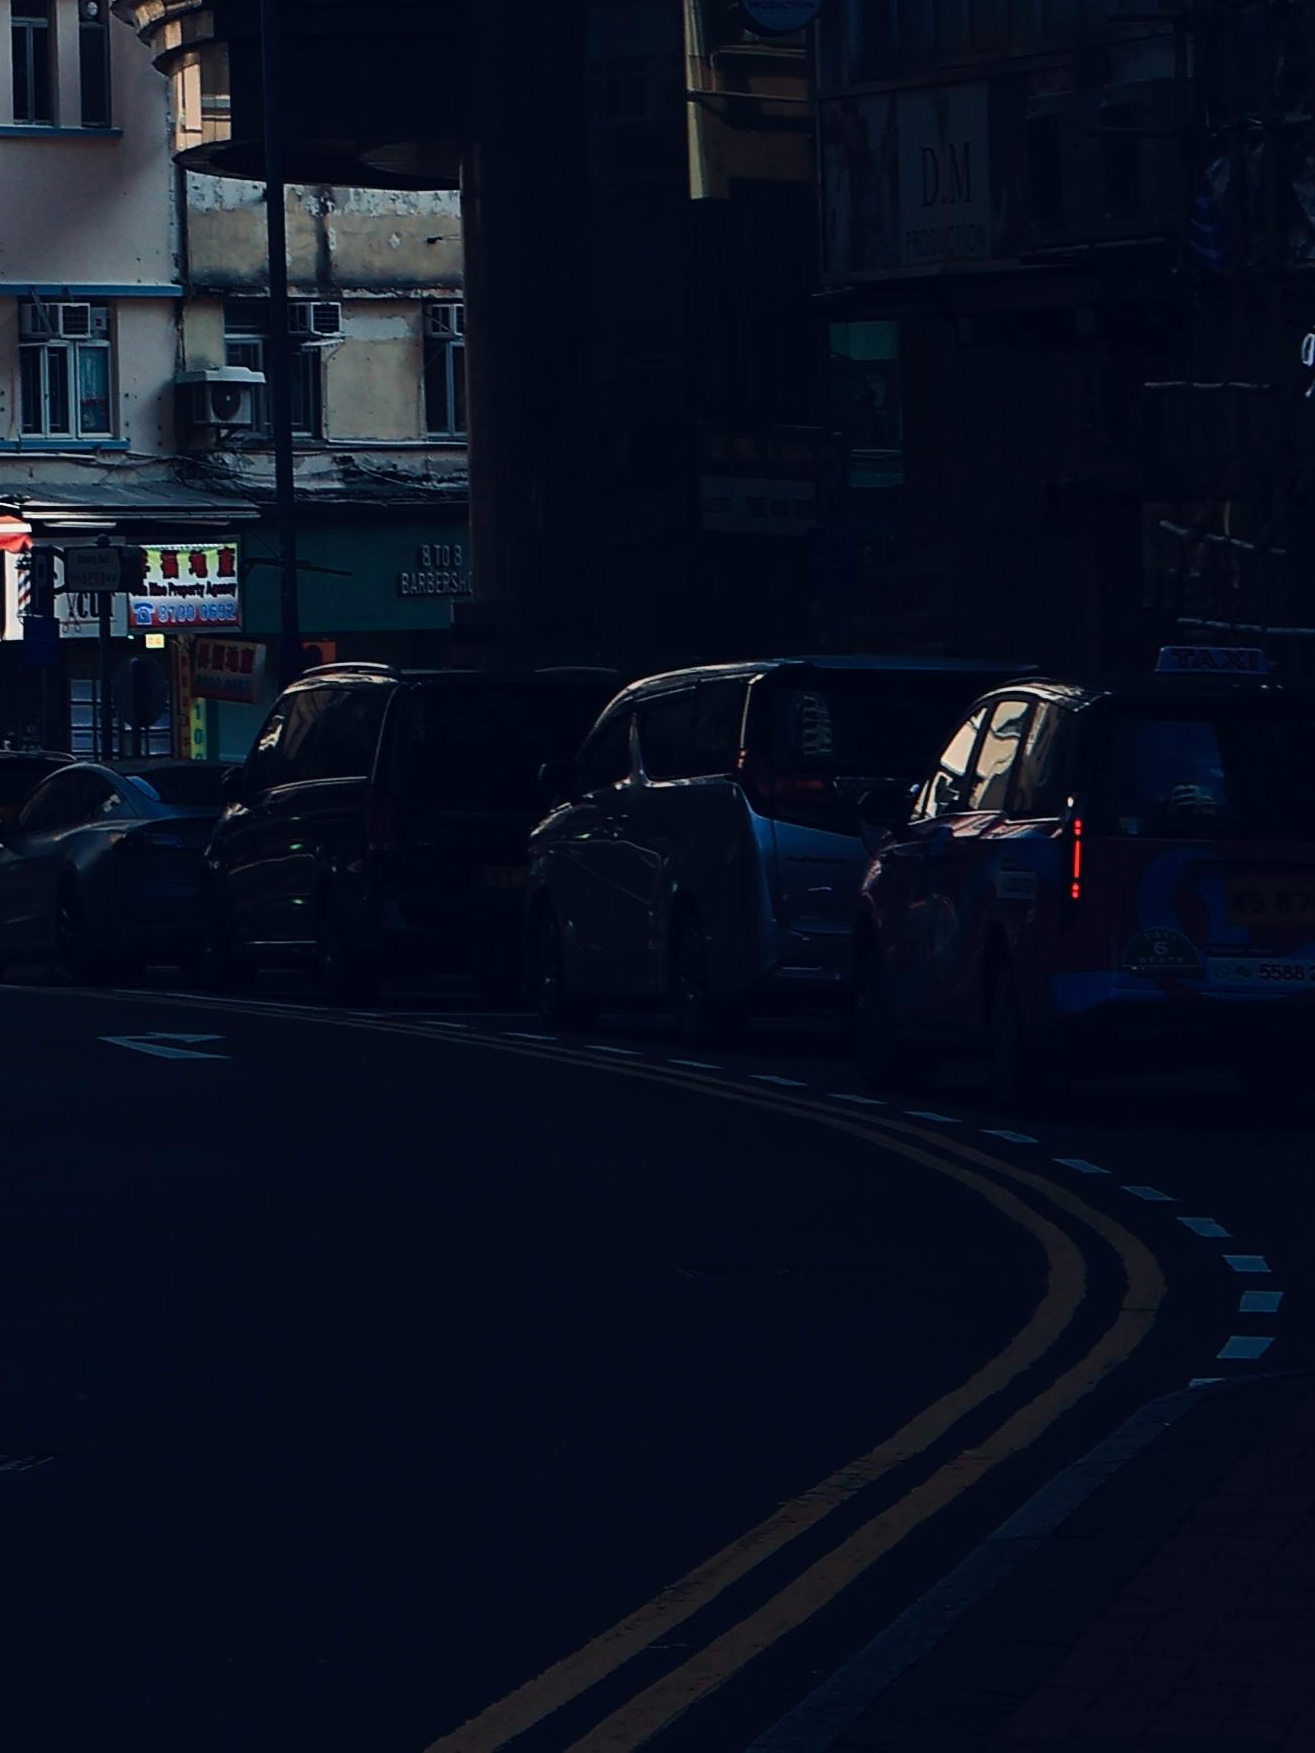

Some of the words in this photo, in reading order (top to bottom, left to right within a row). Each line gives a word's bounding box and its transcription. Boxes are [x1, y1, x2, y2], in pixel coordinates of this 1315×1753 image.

[422, 544, 431, 566] 8
[434, 544, 450, 566] TO
[454, 544, 463, 566] 8
[1171, 649, 1261, 671] TAXI
[1153, 941, 1169, 955] 6
